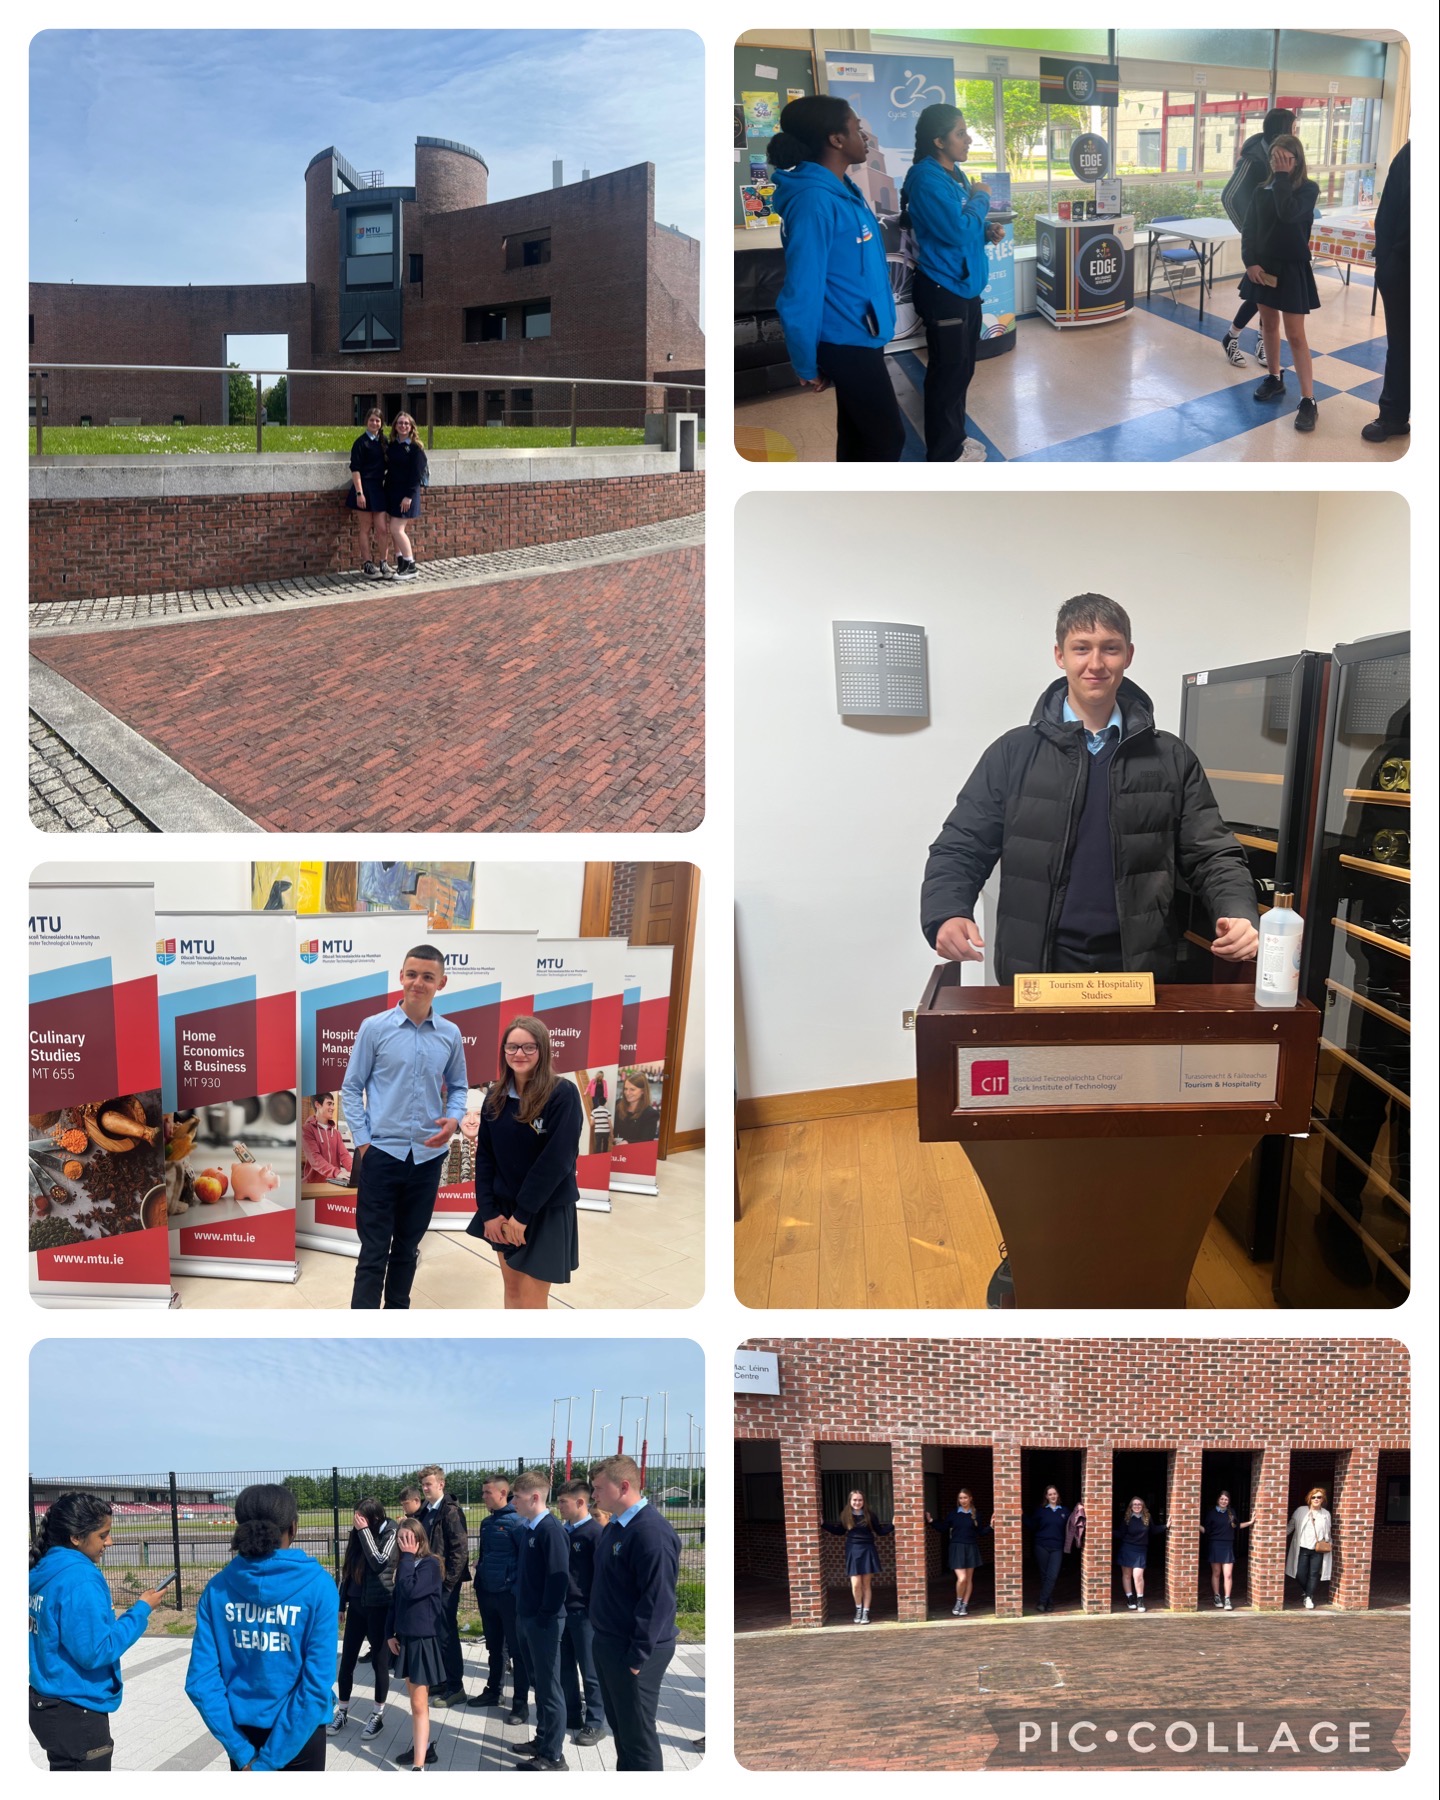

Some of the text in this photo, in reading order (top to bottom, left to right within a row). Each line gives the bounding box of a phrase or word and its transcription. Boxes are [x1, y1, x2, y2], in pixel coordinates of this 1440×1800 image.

[1073, 81, 1088, 91] EDGE
[888, 110, 907, 121] Cycle
[1080, 154, 1102, 167] EDGE
[1090, 257, 1117, 276] EDGE
[180, 939, 215, 954] MTU
[322, 939, 353, 953] MTU
[536, 958, 564, 969] MTU
[1049, 979, 1144, 990] Tourism & Hospitality
[1081, 991, 1113, 1000] Studies
[29, 1030, 86, 1047] Culinary
[182, 1030, 217, 1042] Home
[322, 1029, 358, 1042] Hospita
[549, 1028, 582, 1039] pitality
[30, 1048, 81, 1062] Studies
[183, 1045, 245, 1058] Economics
[322, 1043, 354, 1056] Manag
[550, 1050, 560, 1059] 54
[183, 1060, 247, 1073] & Business
[322, 1057, 348, 1068] MT 55
[32, 1067, 75, 1080] MT 655
[183, 1077, 221, 1088] MT 930
[981, 1076, 1006, 1092] CIT
[1074, 1083, 1117, 1091] Technology
[1222, 1081, 1262, 1089] Hospitality
[438, 1191, 477, 1199] www.mt
[194, 1231, 256, 1243] www.mtu.ie
[53, 1253, 124, 1265] www.mtu.ie
[734, 1372, 760, 1380] Centre
[225, 1602, 302, 1627] STUDENT
[232, 1629, 292, 1653] LEADER
